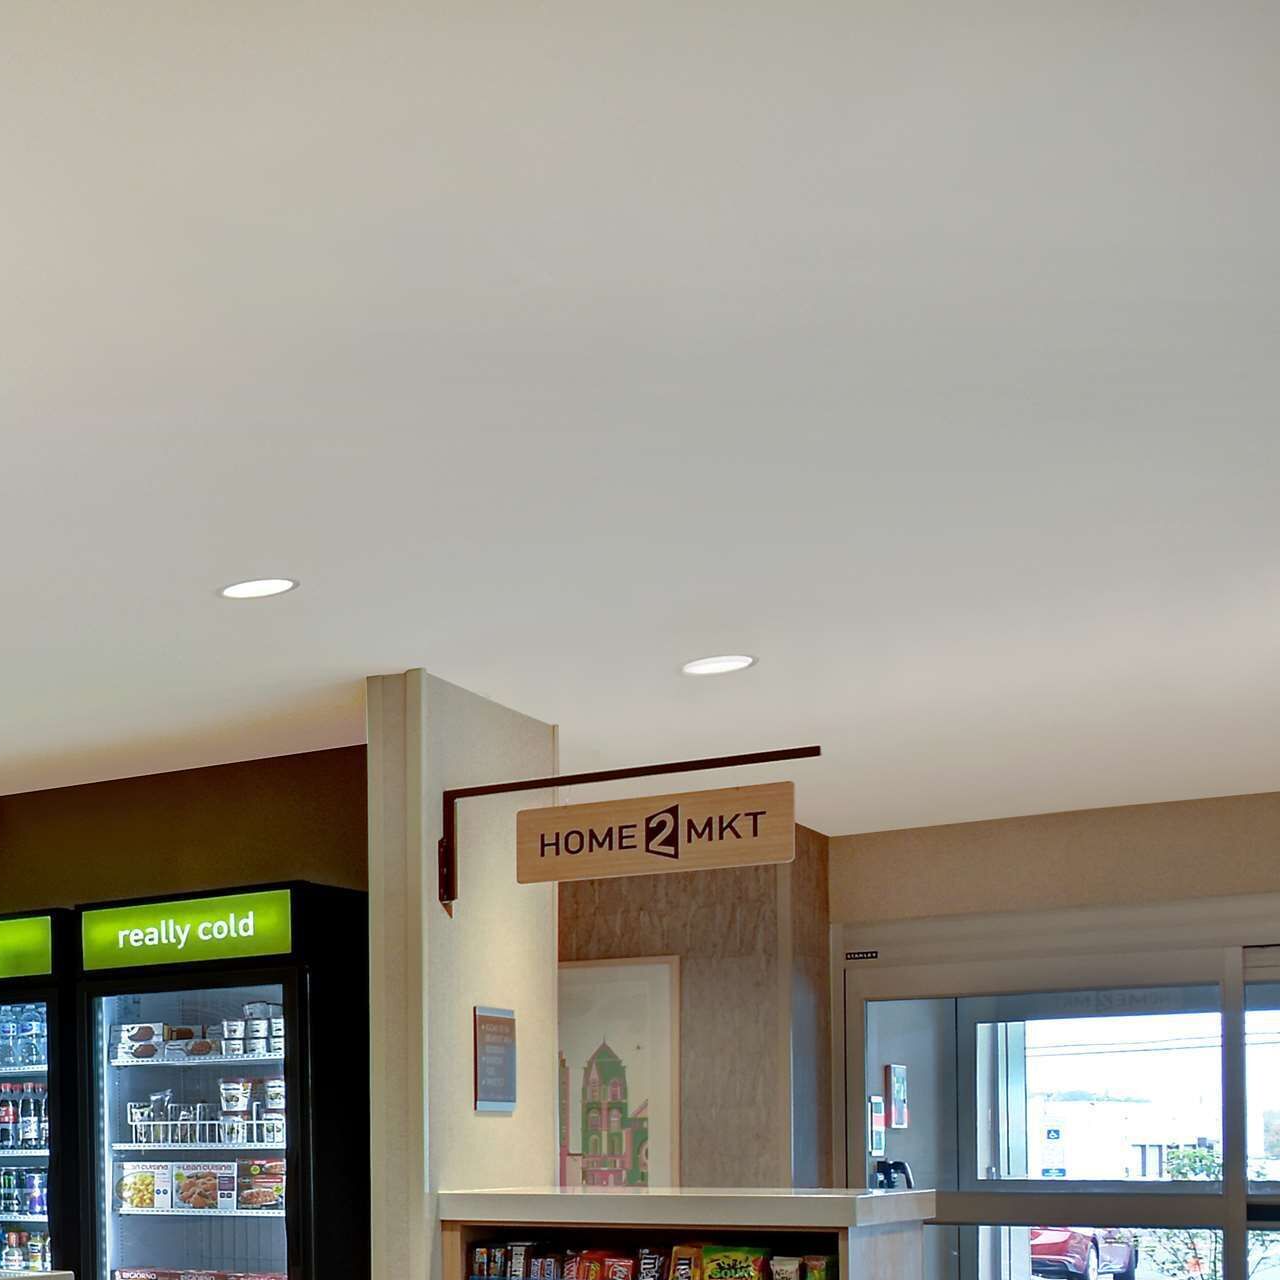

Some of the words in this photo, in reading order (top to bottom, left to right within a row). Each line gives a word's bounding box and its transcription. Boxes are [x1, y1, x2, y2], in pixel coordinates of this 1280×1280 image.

[540, 824, 638, 858] HOME
[687, 811, 767, 844] MKT
[117, 919, 191, 950] really
[198, 911, 255, 941] cold
